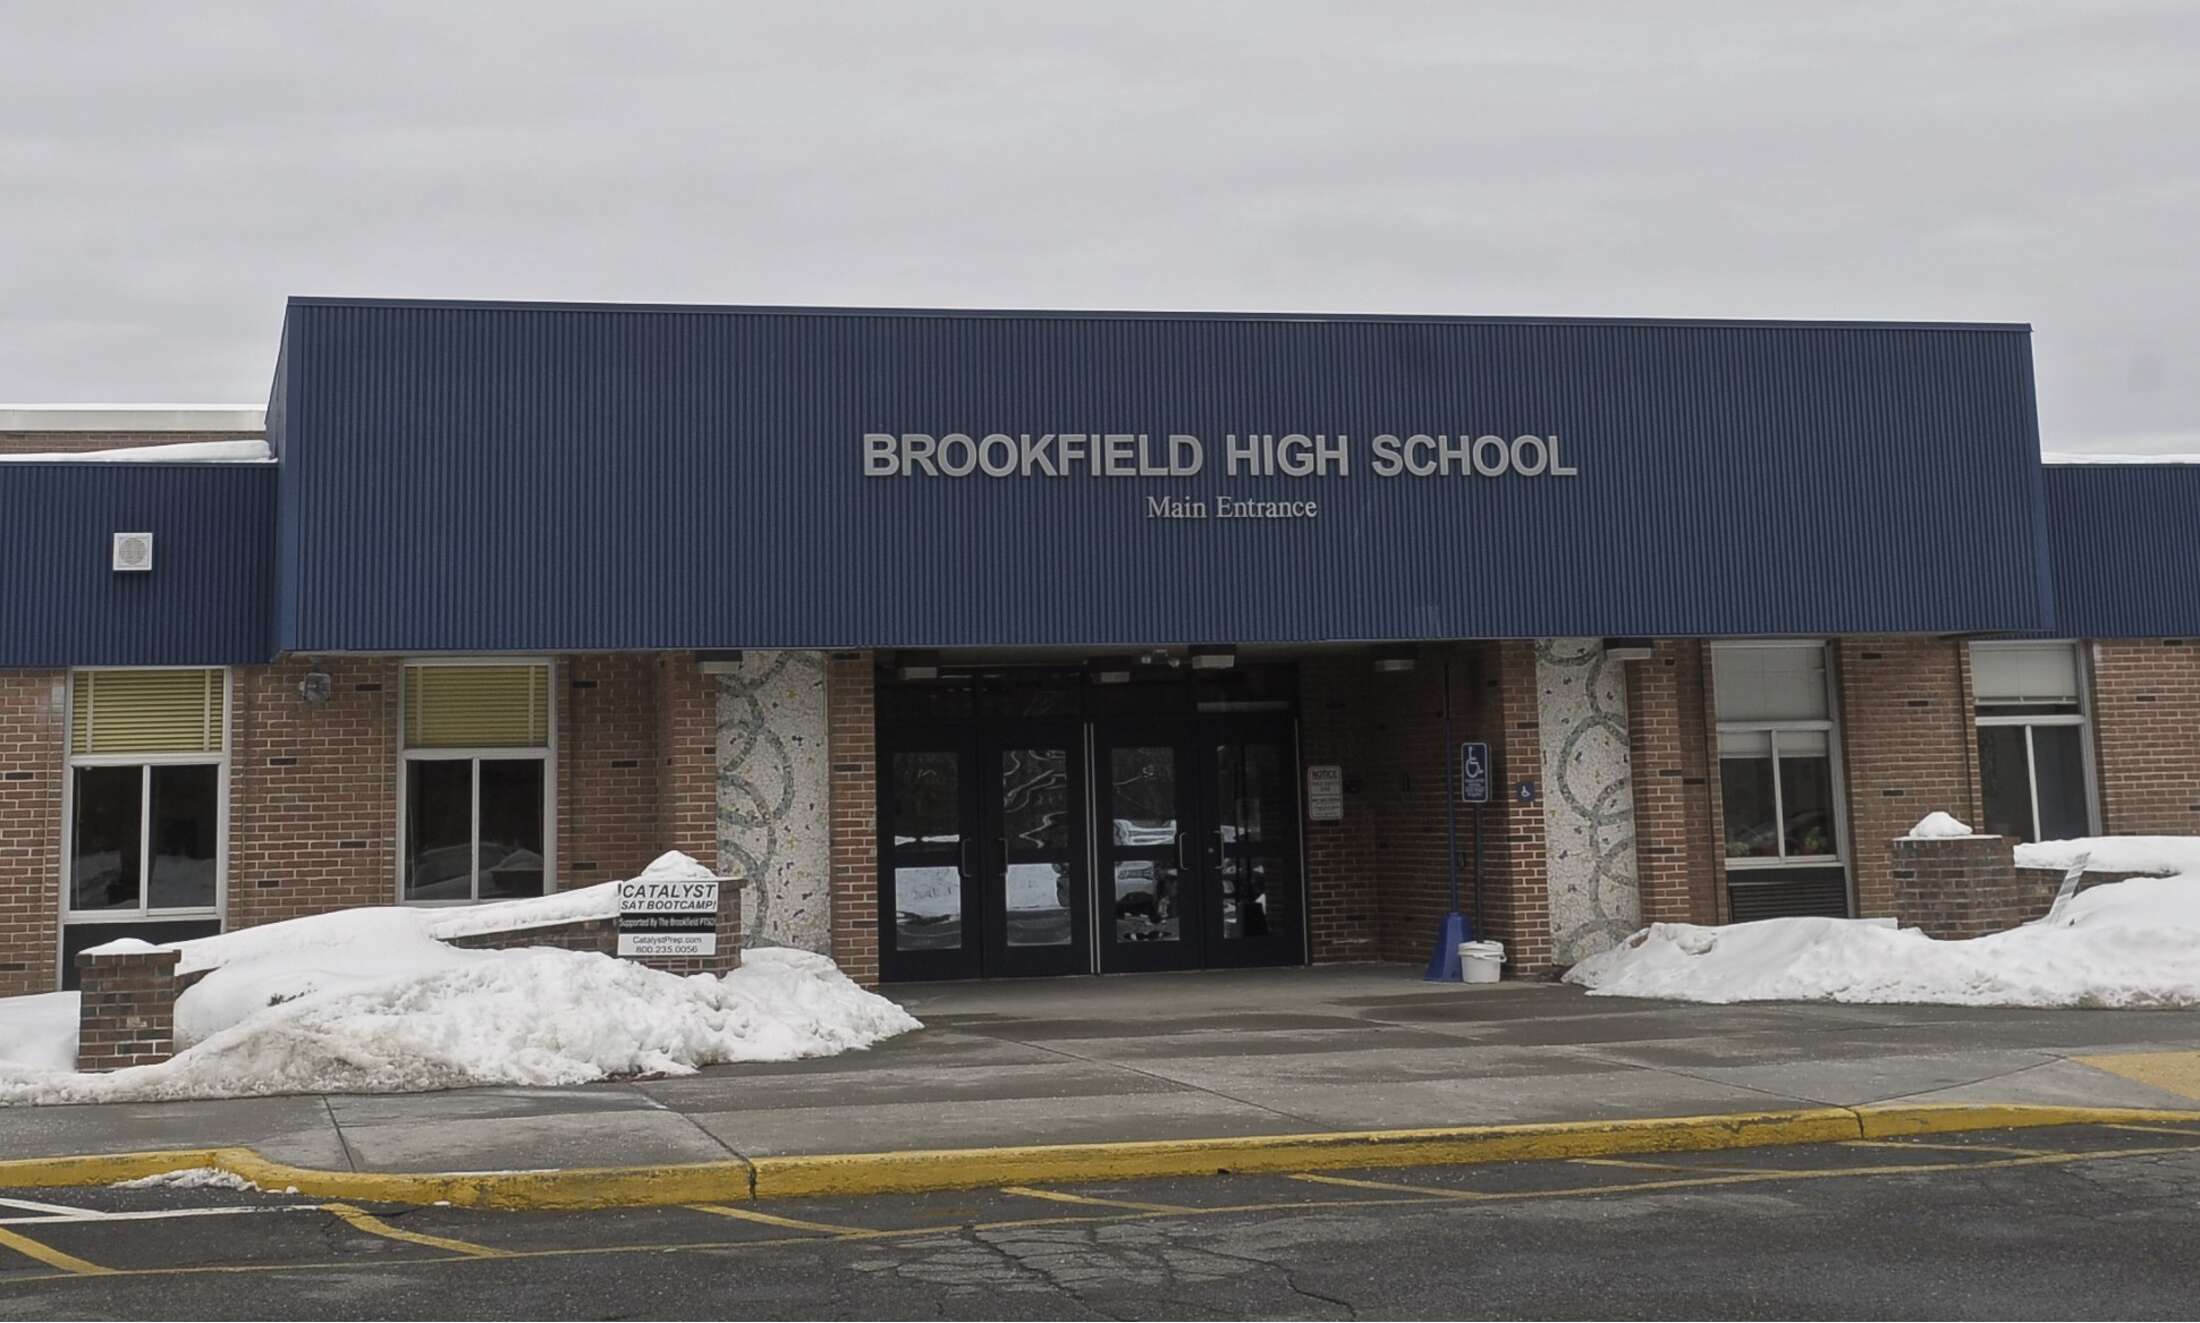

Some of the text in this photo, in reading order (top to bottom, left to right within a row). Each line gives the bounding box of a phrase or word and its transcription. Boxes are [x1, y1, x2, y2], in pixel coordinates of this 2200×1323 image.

[863, 433, 1579, 477] BROOKFIELD HIGH SCHOOL
[1147, 496, 1318, 518] Main Entrance
[622, 884, 716, 898] CATALYST
[621, 900, 645, 910] SAT
